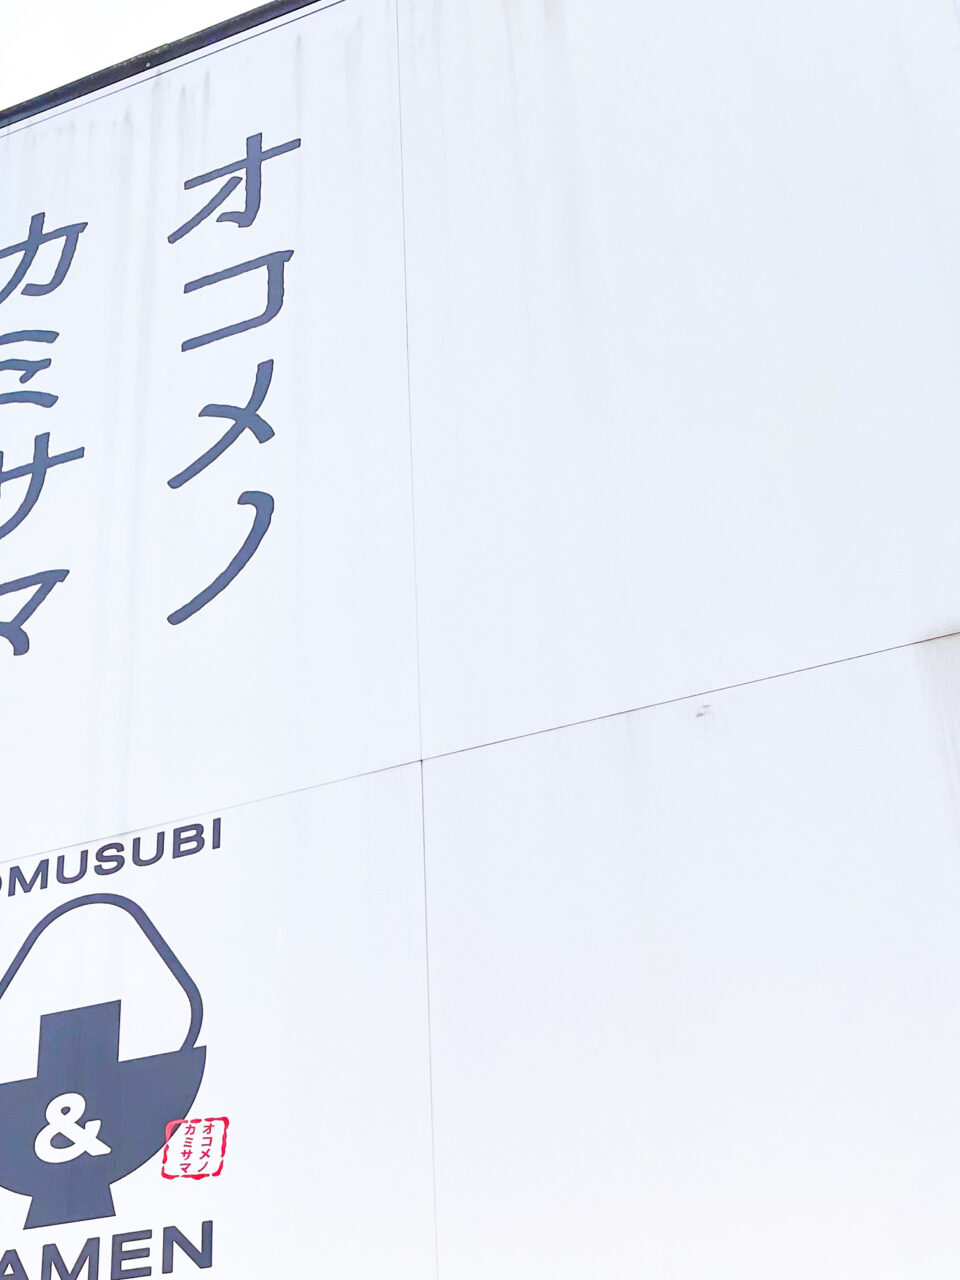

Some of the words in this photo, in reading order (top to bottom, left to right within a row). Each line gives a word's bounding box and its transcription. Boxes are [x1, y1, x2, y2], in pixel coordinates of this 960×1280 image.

[166, 132, 302, 626] オコメノ
[34, 1091, 112, 1164] &
[179, 1124, 196, 1173] カミサマ
[197, 1123, 215, 1172] オコメノ
